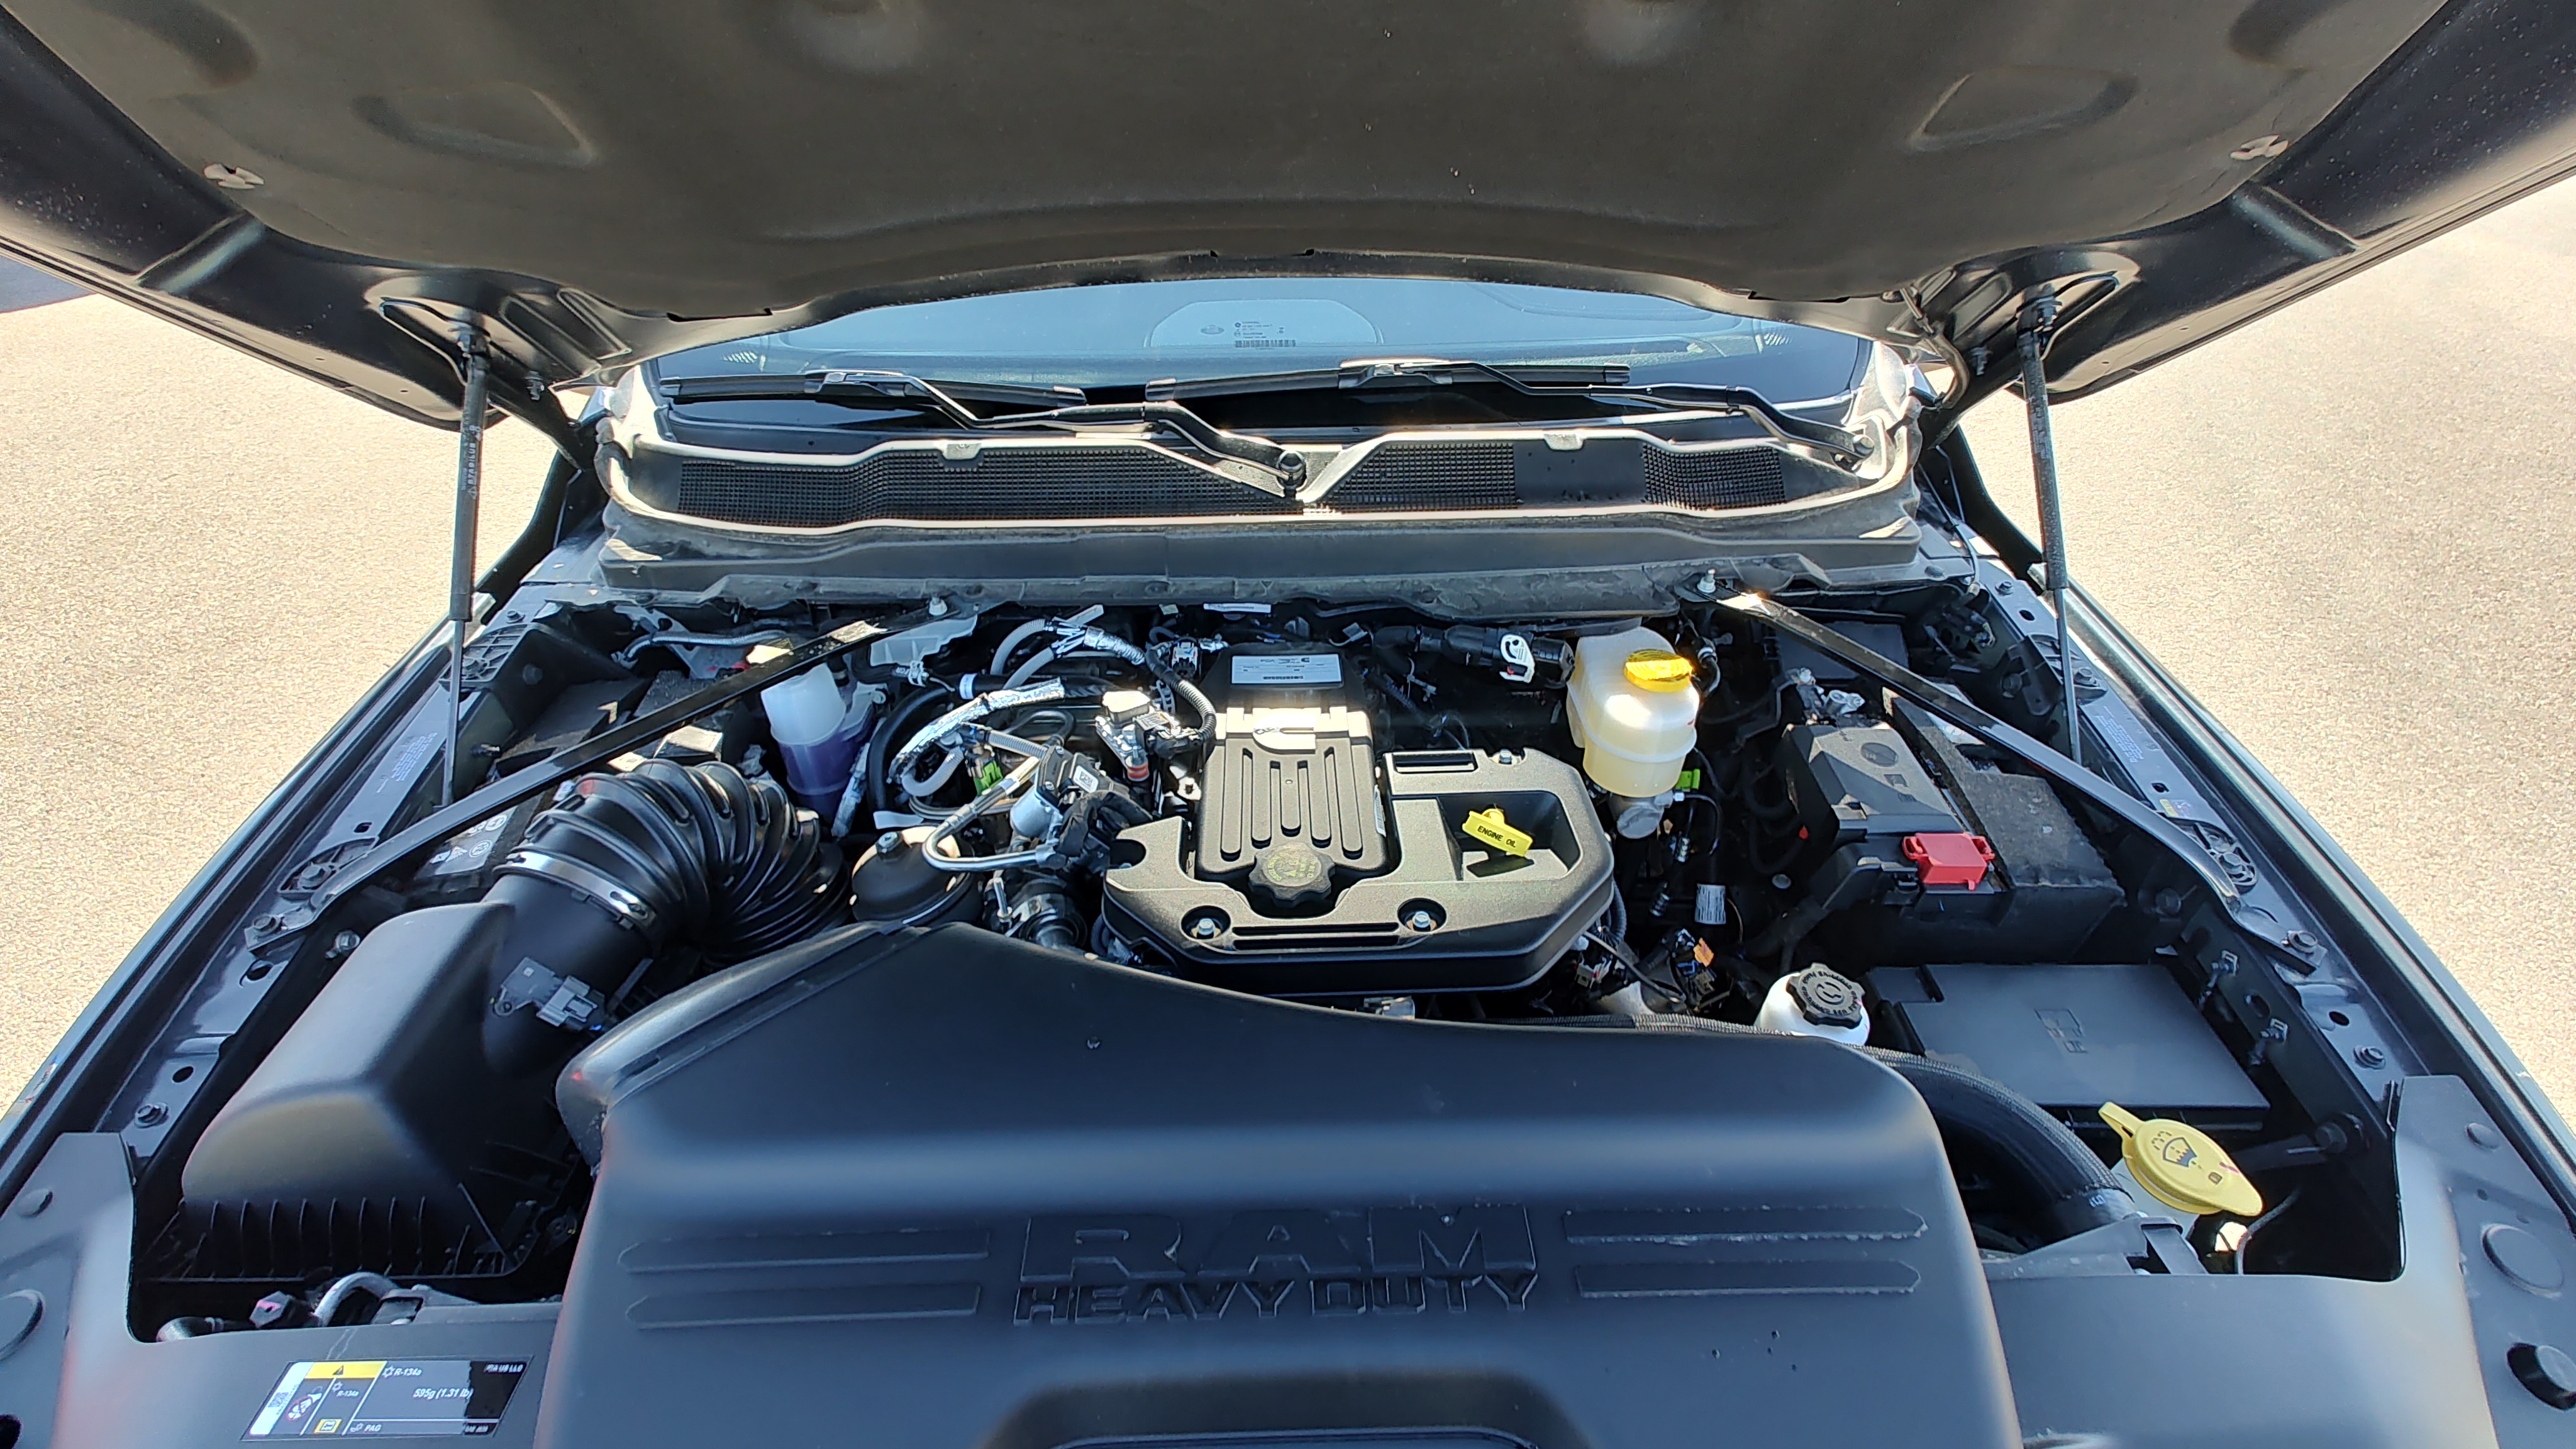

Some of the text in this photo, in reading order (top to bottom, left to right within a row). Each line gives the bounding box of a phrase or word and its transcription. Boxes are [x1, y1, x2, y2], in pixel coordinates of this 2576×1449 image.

[1477, 825, 1516, 848] ENGINE OIL
[1021, 1206, 1536, 1282] RAM
[1013, 1273, 1538, 1324] HEAVY DUTY
[394, 1368, 422, 1377] R-134a
[413, 1387, 474, 1400] 595g (1.31 lb)
[364, 1424, 382, 1432] PAG
